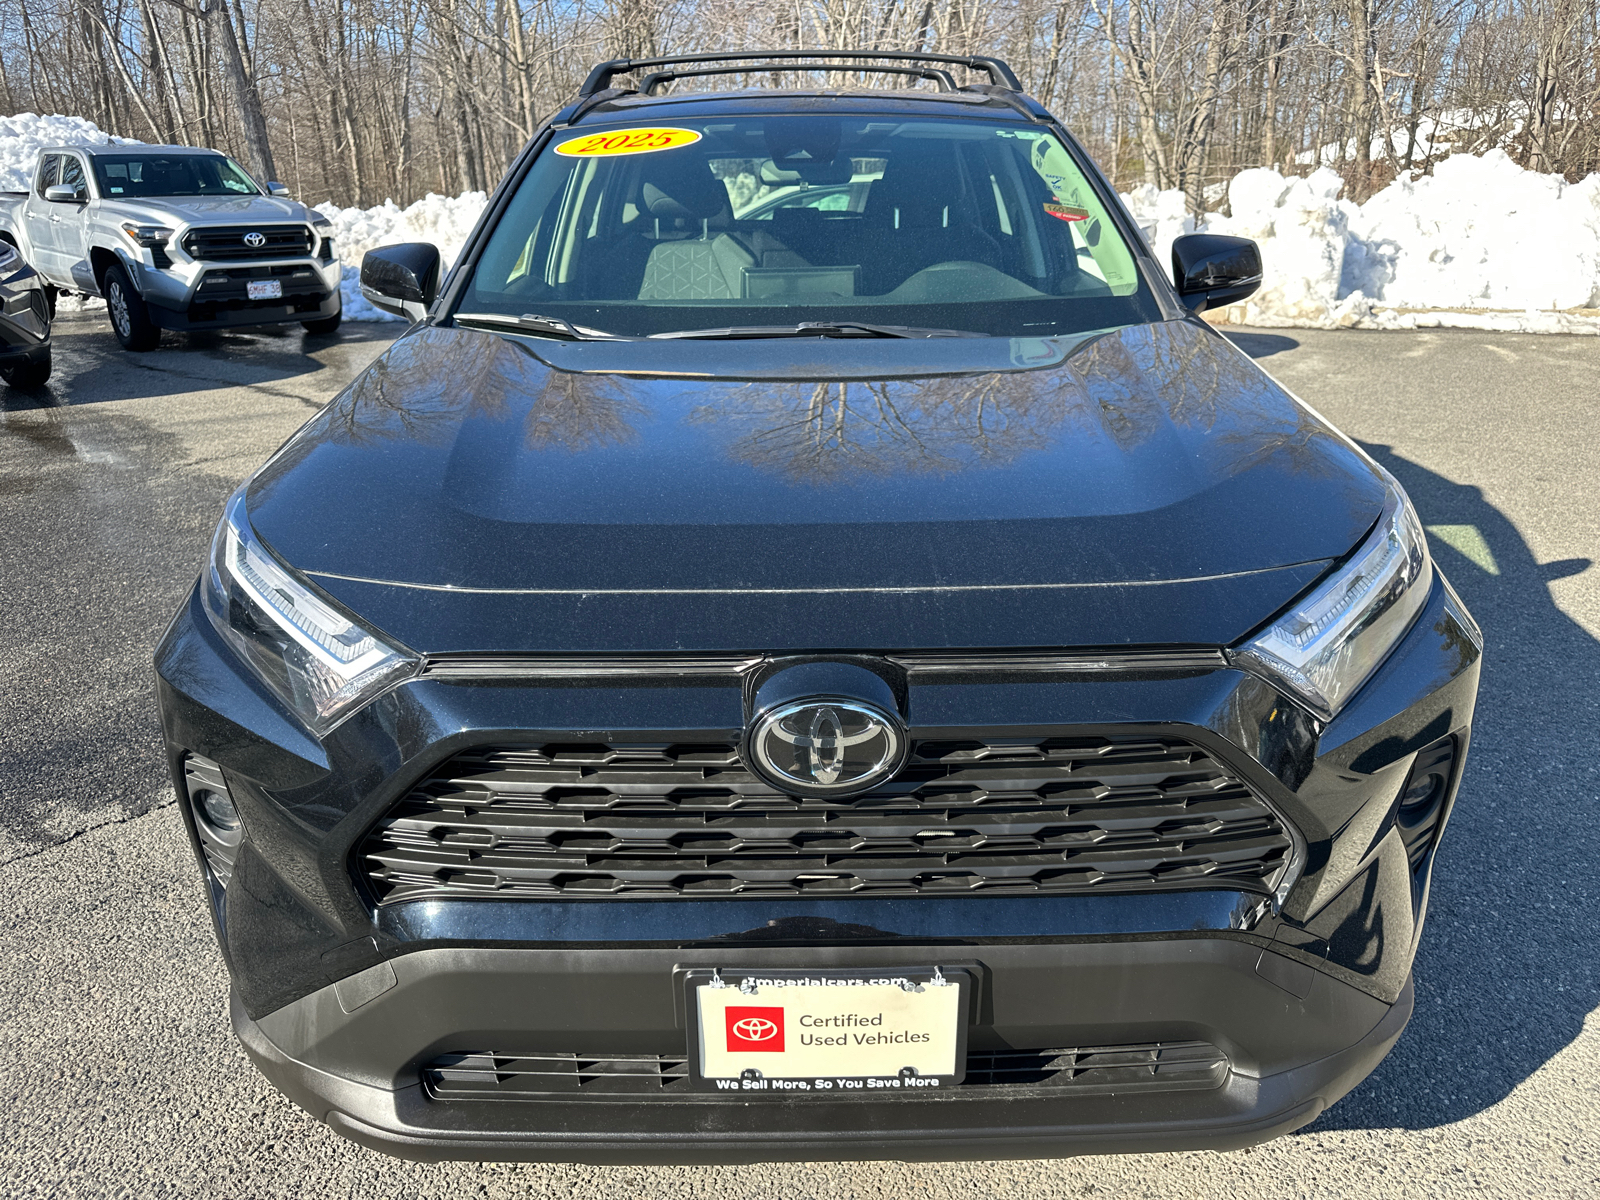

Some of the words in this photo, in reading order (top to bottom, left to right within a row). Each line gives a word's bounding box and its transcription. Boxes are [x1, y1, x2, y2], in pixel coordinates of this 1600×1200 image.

[577, 132, 679, 153] 2025
[800, 1013, 882, 1027] Certified
[801, 1033, 847, 1046] Used
[853, 1030, 930, 1045] Vehicles
[716, 1080, 739, 1089] We
[742, 1080, 768, 1089] Sell
[772, 1080, 811, 1091] More,
[815, 1080, 833, 1089] So
[837, 1079, 863, 1089] You
[867, 1078, 900, 1088] Save
[905, 1077, 939, 1087] More
